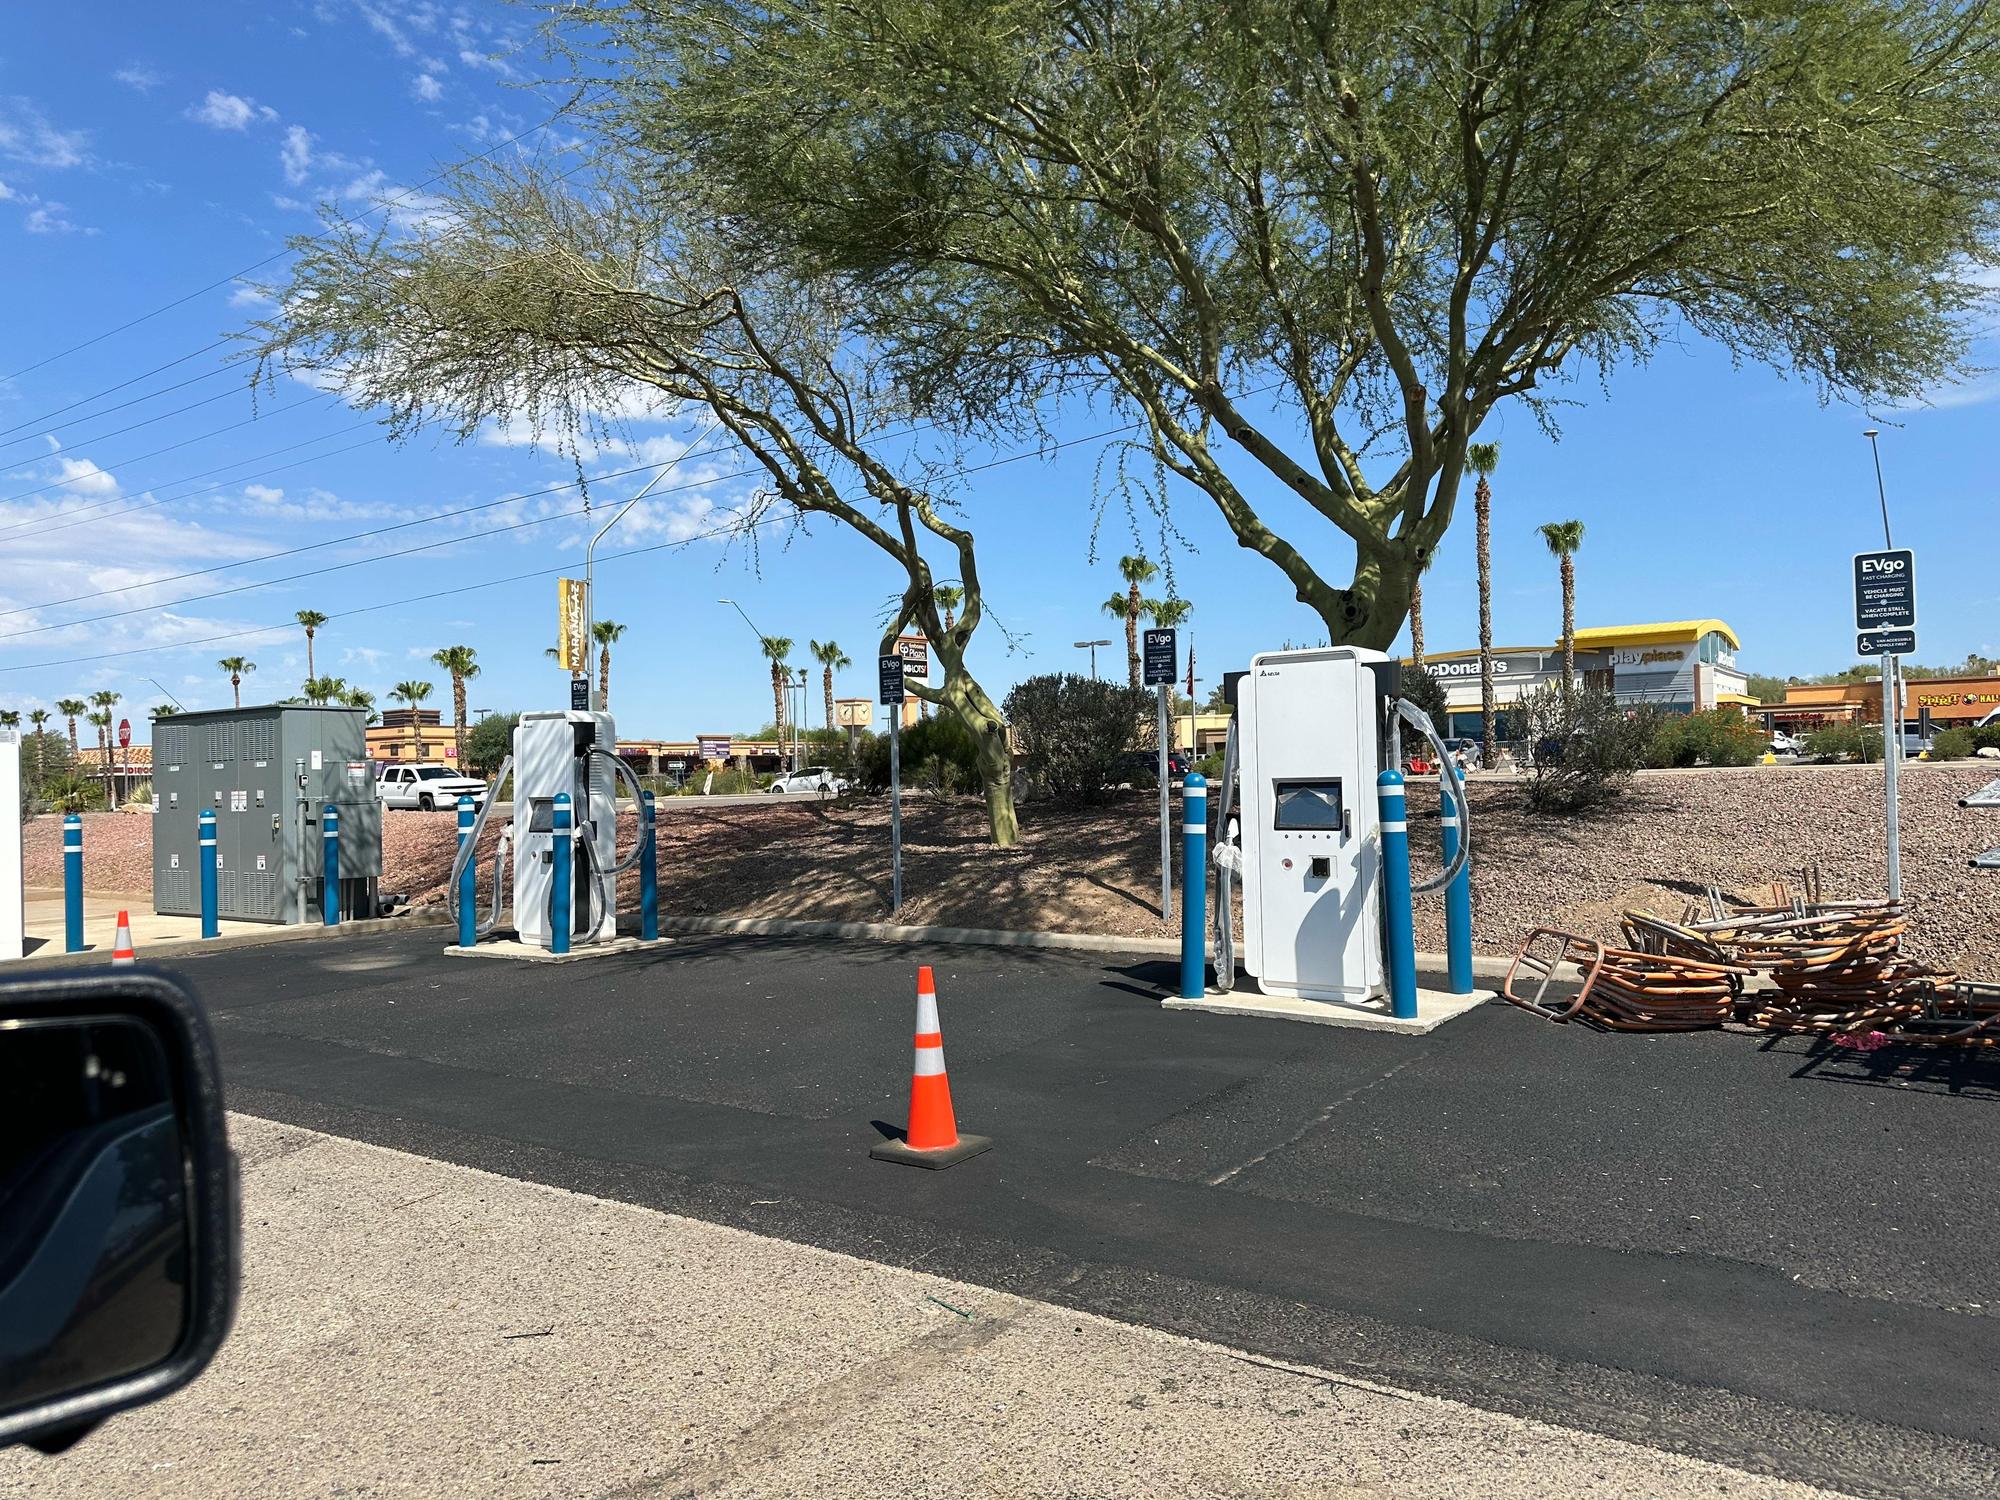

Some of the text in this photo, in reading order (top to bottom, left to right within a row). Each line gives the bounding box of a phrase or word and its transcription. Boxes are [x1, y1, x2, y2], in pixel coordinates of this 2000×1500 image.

[1862, 558, 1904, 574] EVgo
[1148, 634, 1171, 645] EVgo
[882, 660, 899, 669] EVgo
[1919, 693, 1960, 706] SPIRIT
[120, 728, 130, 739] STOP
